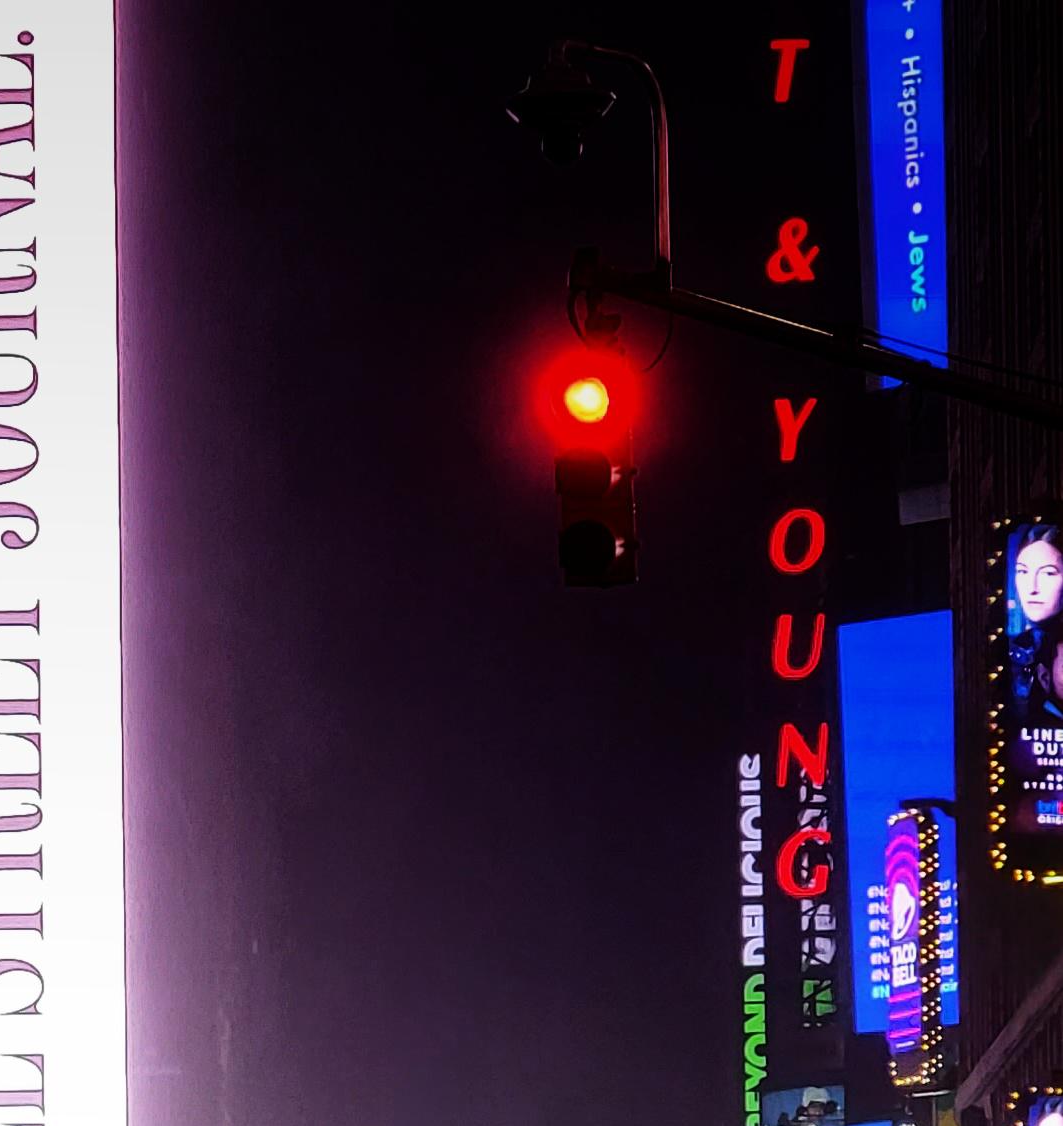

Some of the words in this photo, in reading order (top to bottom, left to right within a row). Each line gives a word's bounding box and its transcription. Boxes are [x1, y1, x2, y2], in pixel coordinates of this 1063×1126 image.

[898, 56, 926, 189] Hispanics
[765, 217, 820, 284] &
[908, 231, 930, 314] Jews
[768, 397, 833, 899] YOUNG
[1033, 742, 1063, 755] DU
[891, 942, 917, 967] TACO
[893, 964, 918, 988] BELL
